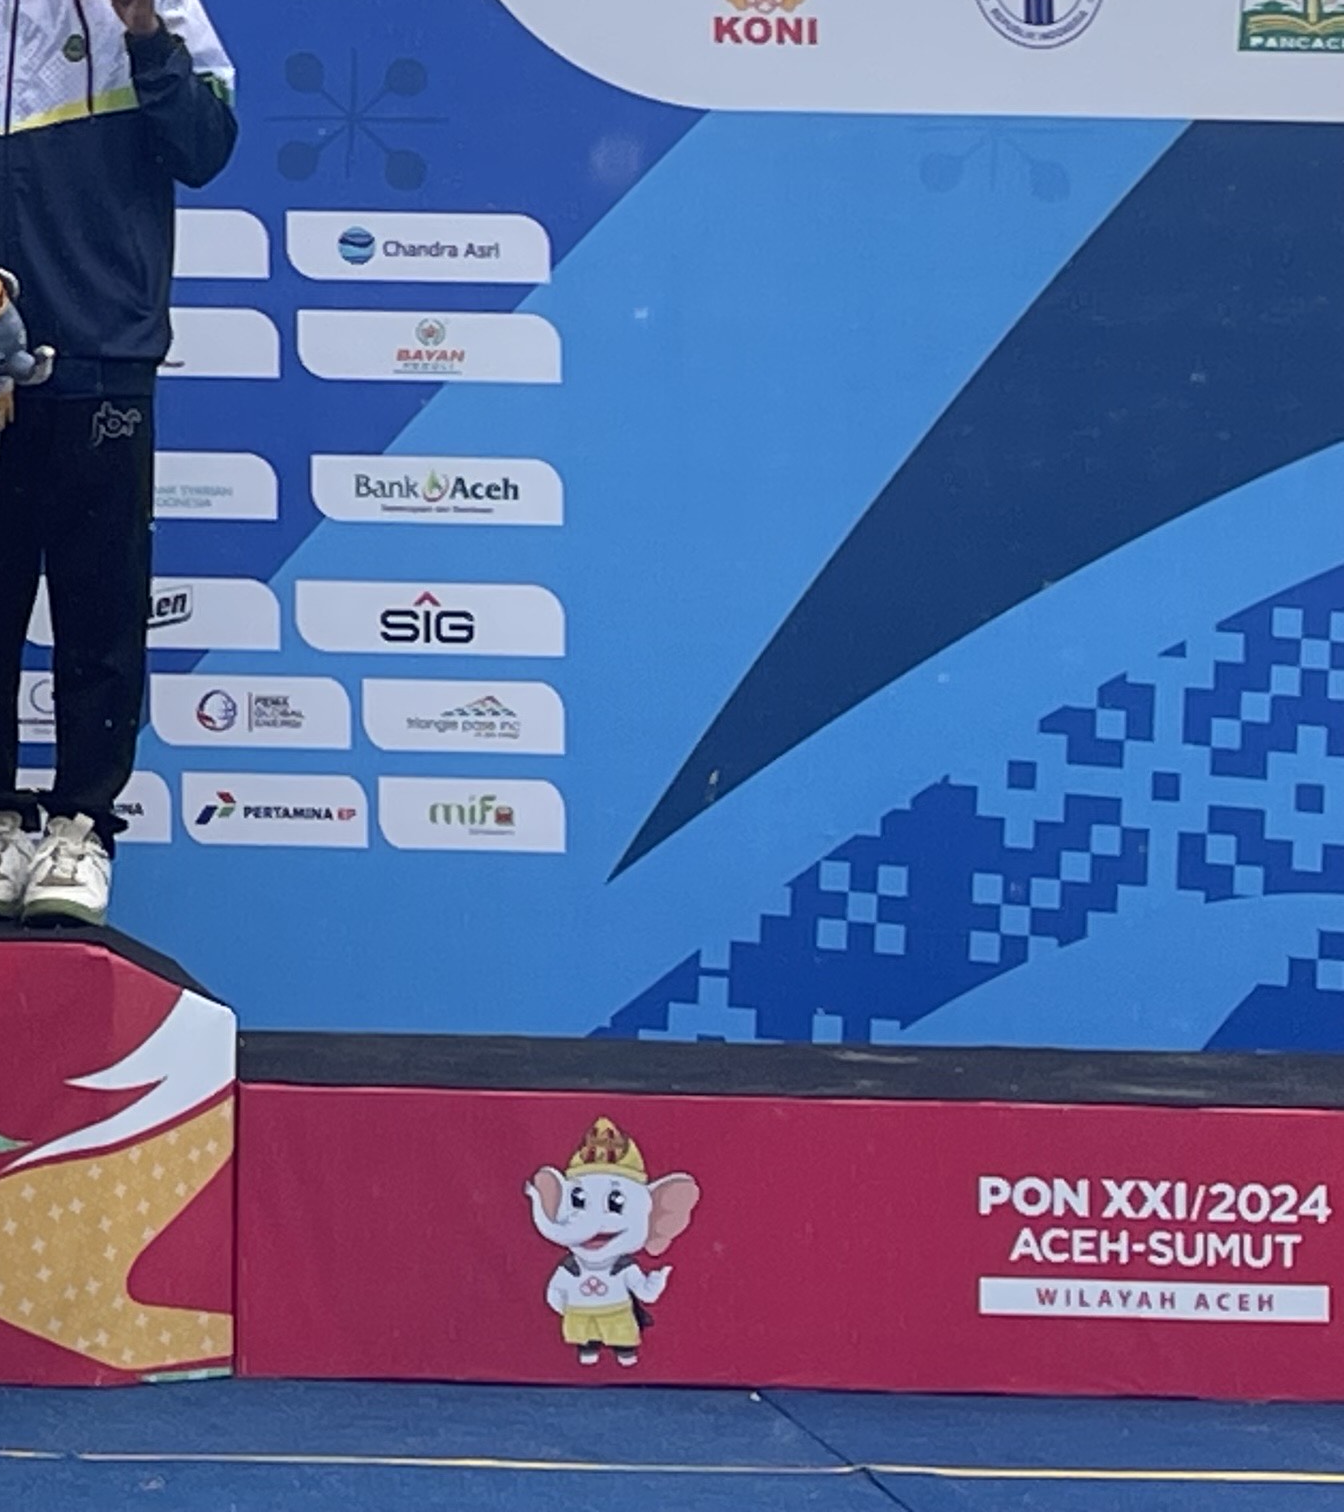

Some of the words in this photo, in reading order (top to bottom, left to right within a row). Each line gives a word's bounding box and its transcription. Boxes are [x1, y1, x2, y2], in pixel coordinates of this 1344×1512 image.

[713, 16, 819, 46] KONI
[383, 241, 459, 259] Chandra
[463, 242, 501, 259] Asri
[396, 349, 465, 362] BAYAN
[355, 474, 419, 499] Bank
[449, 476, 520, 500] Aceh
[380, 609, 475, 644] SIG
[243, 805, 334, 821] PERTAMINA
[338, 808, 356, 821] EP
[978, 1176, 1091, 1217] PON
[1101, 1178, 1332, 1224] XXI/2024
[1009, 1227, 1302, 1268] ACEH-SUMUT
[1036, 1288, 1176, 1310] WILAYAH
[1194, 1293, 1275, 1312] ACEH
